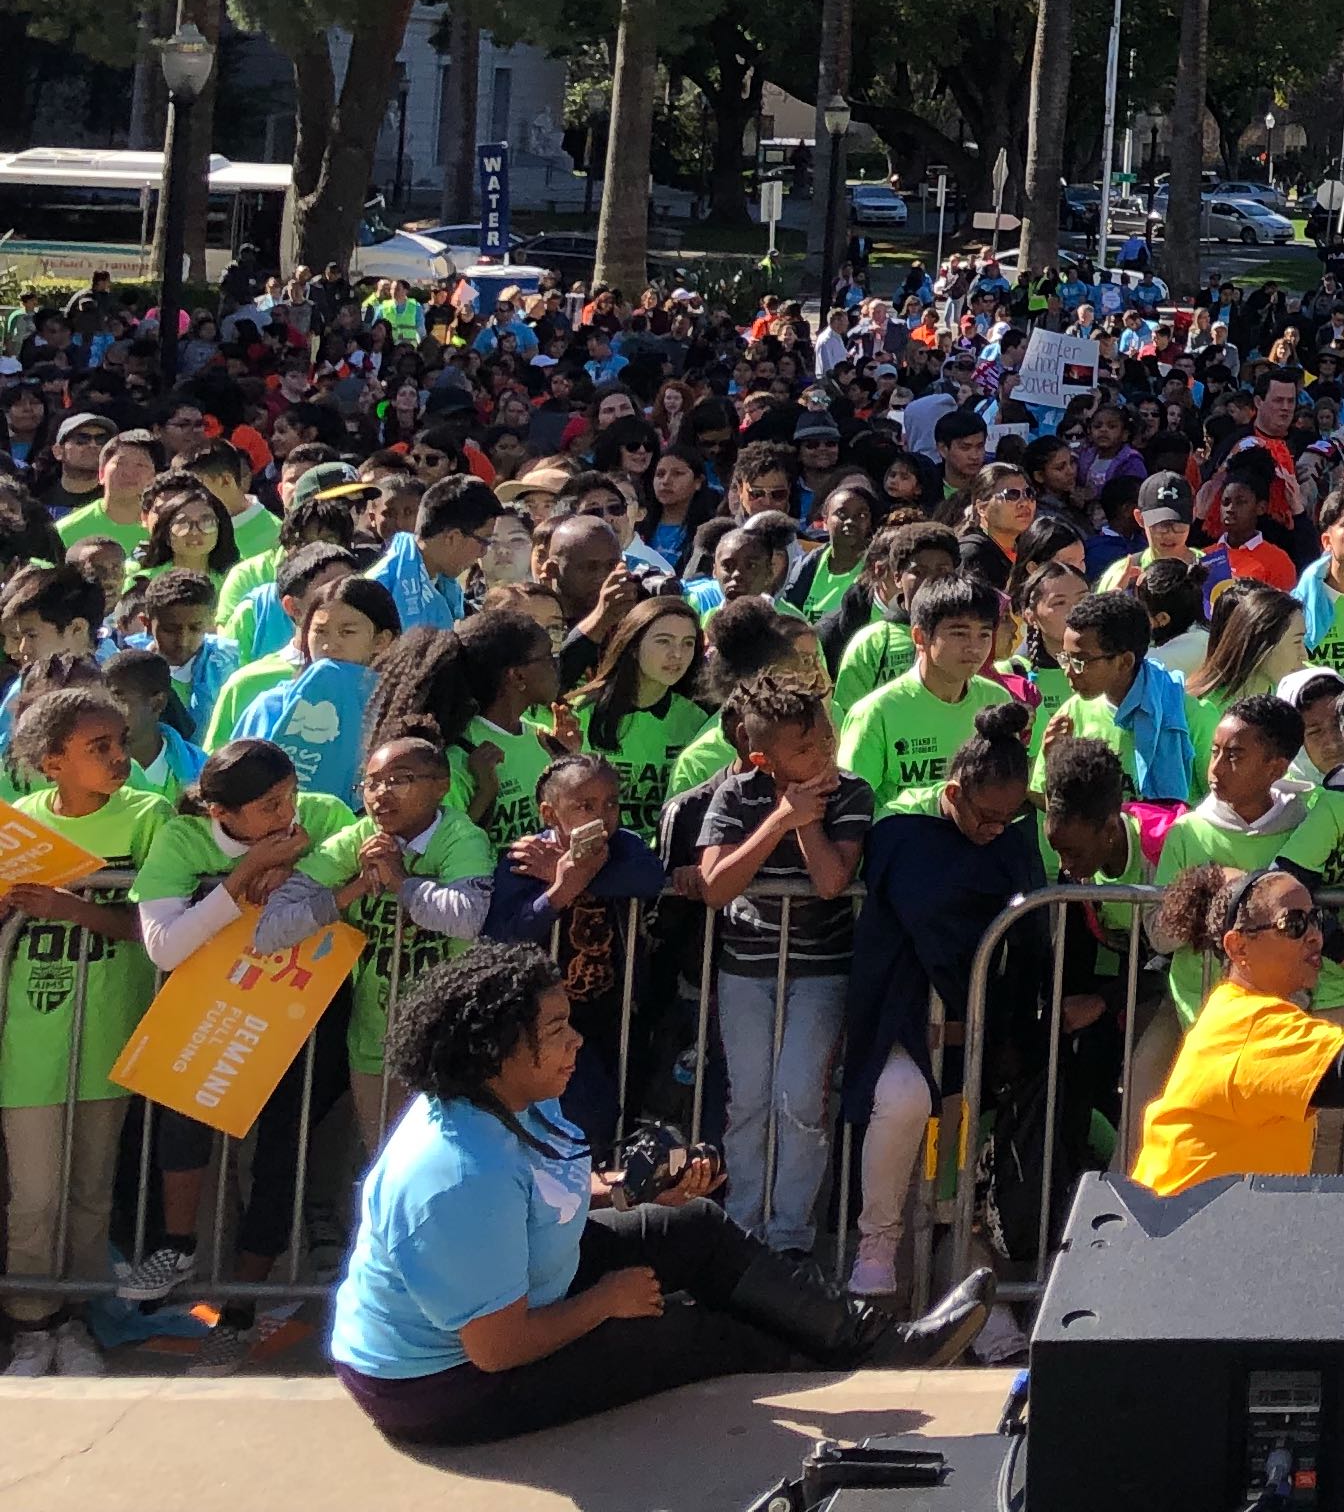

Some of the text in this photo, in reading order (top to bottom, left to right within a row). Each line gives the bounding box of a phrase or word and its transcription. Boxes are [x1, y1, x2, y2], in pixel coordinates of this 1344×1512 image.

[484, 156, 501, 246] WATER
[900, 757, 948, 783] WE
[172, 1000, 227, 1073] FUNDING
[195, 1014, 269, 1108] DEMAND
[208, 1006, 243, 1046] FULL
